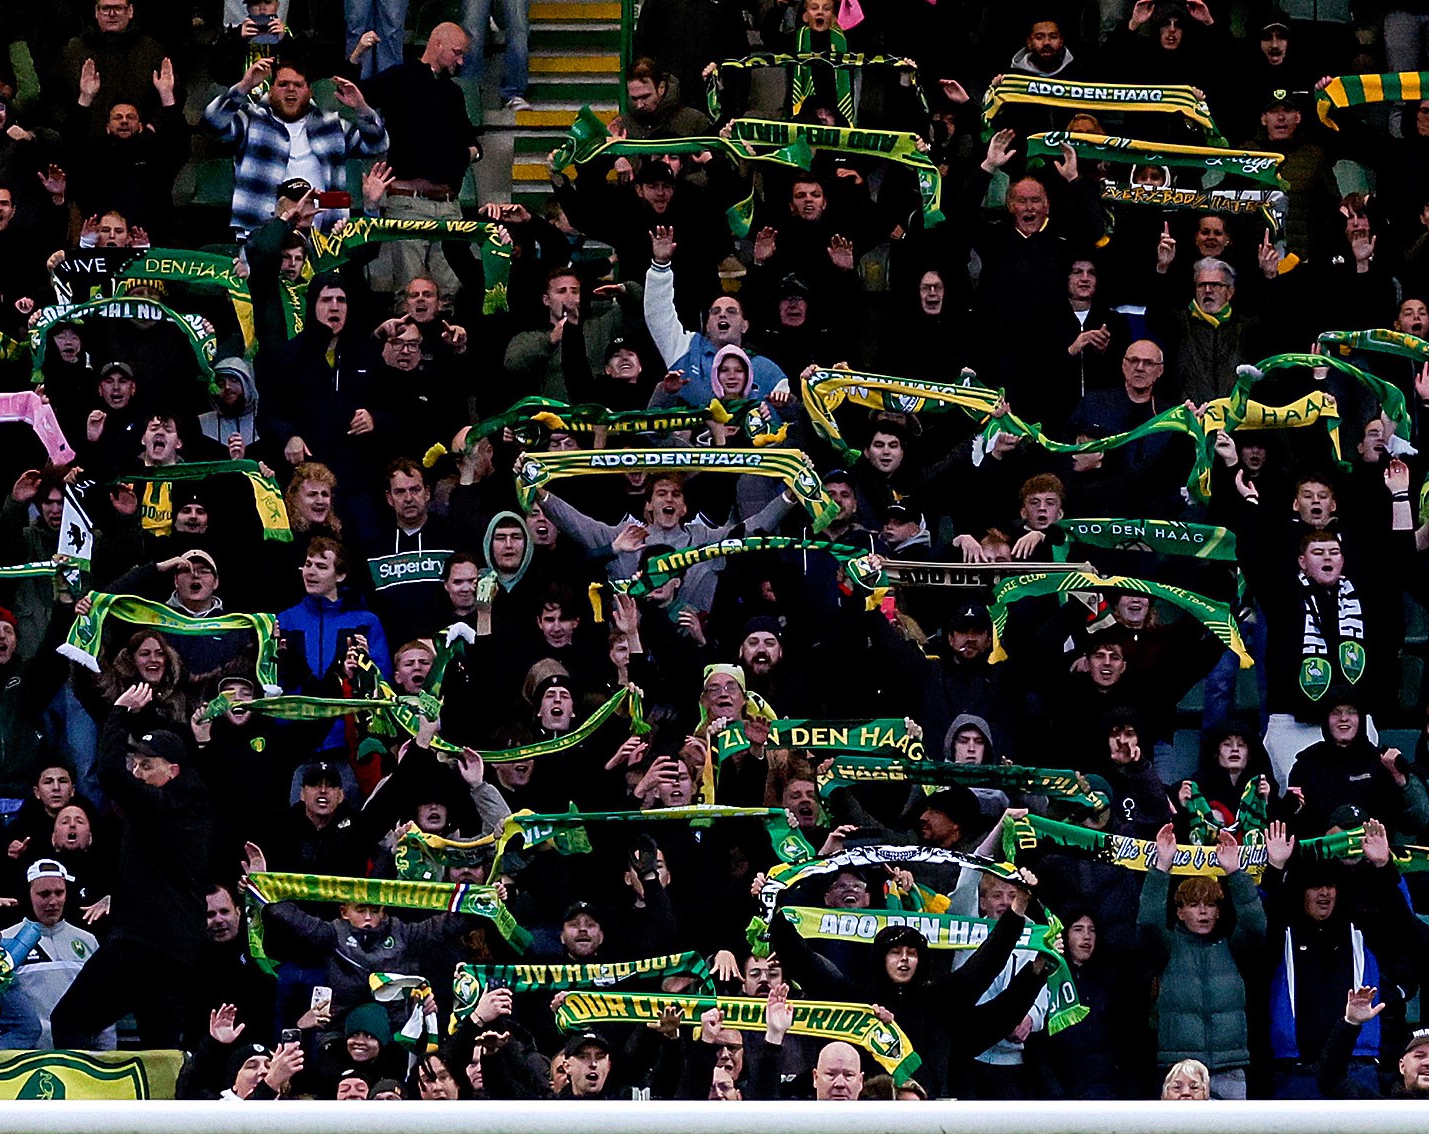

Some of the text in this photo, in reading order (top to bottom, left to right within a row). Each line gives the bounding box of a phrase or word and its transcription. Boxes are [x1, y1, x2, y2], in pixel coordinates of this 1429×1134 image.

[1028, 82, 1162, 102] ADO DEN HAAG
[146, 259, 187, 274] DEN
[590, 452, 763, 467] ADO DEN HAAG
[1112, 526, 1145, 538] DEN
[1156, 530, 1205, 544] HAAG
[379, 558, 445, 579] Superdry
[725, 726, 928, 762] ZIN DEN HAAG
[820, 916, 877, 938] ADO
[566, 992, 629, 1019] OUR
[791, 1004, 875, 1039] PRIDE
